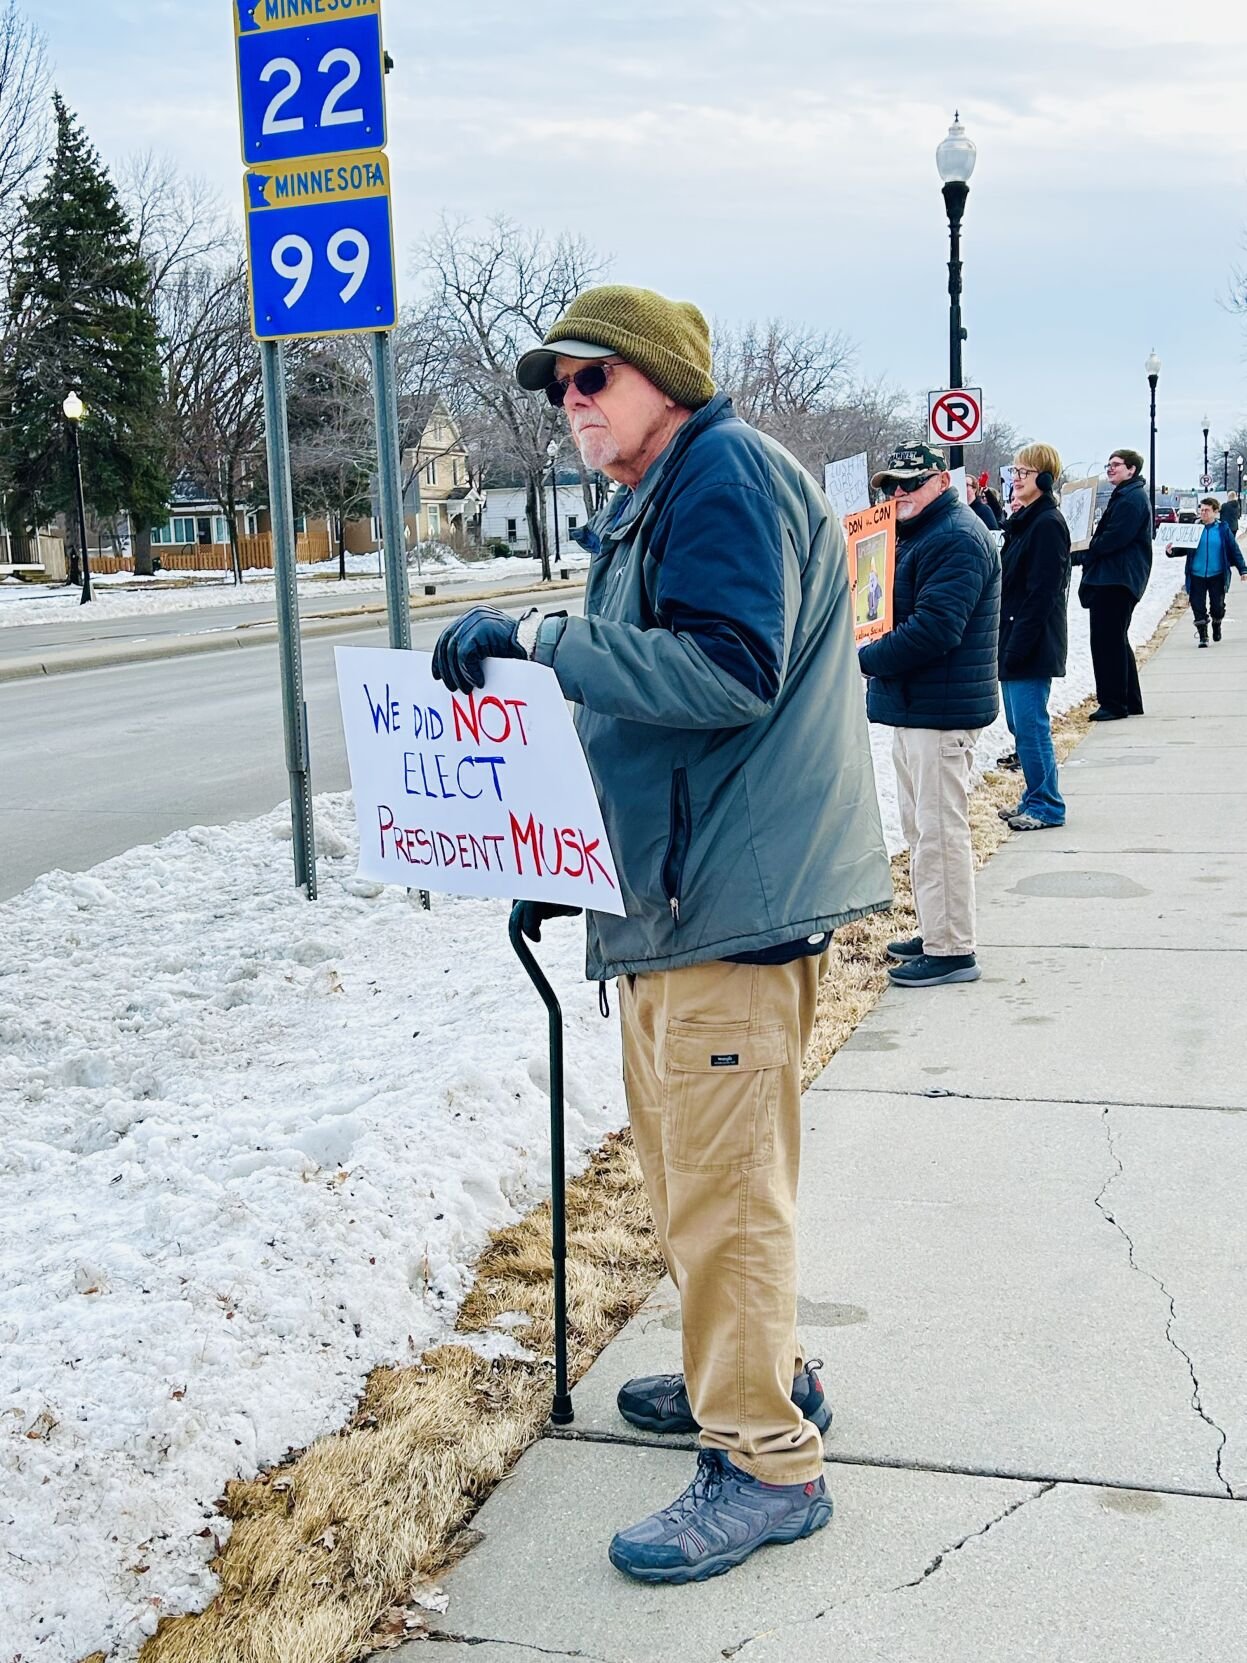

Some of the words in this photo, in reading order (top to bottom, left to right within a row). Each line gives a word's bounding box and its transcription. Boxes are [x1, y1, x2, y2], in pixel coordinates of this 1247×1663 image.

[265, 0, 376, 21] MINNE
[259, 48, 364, 135] 22
[275, 163, 384, 198] MINNESOTA
[271, 228, 370, 309] 99
[848, 516, 862, 536] DON
[873, 505, 890, 524] CON
[363, 683, 401, 734] WE
[413, 704, 444, 740] DID
[452, 691, 528, 746] NOT
[404, 752, 506, 801] ELECT
[377, 805, 505, 872] PRESIDENT
[509, 810, 615, 889] MUSK
